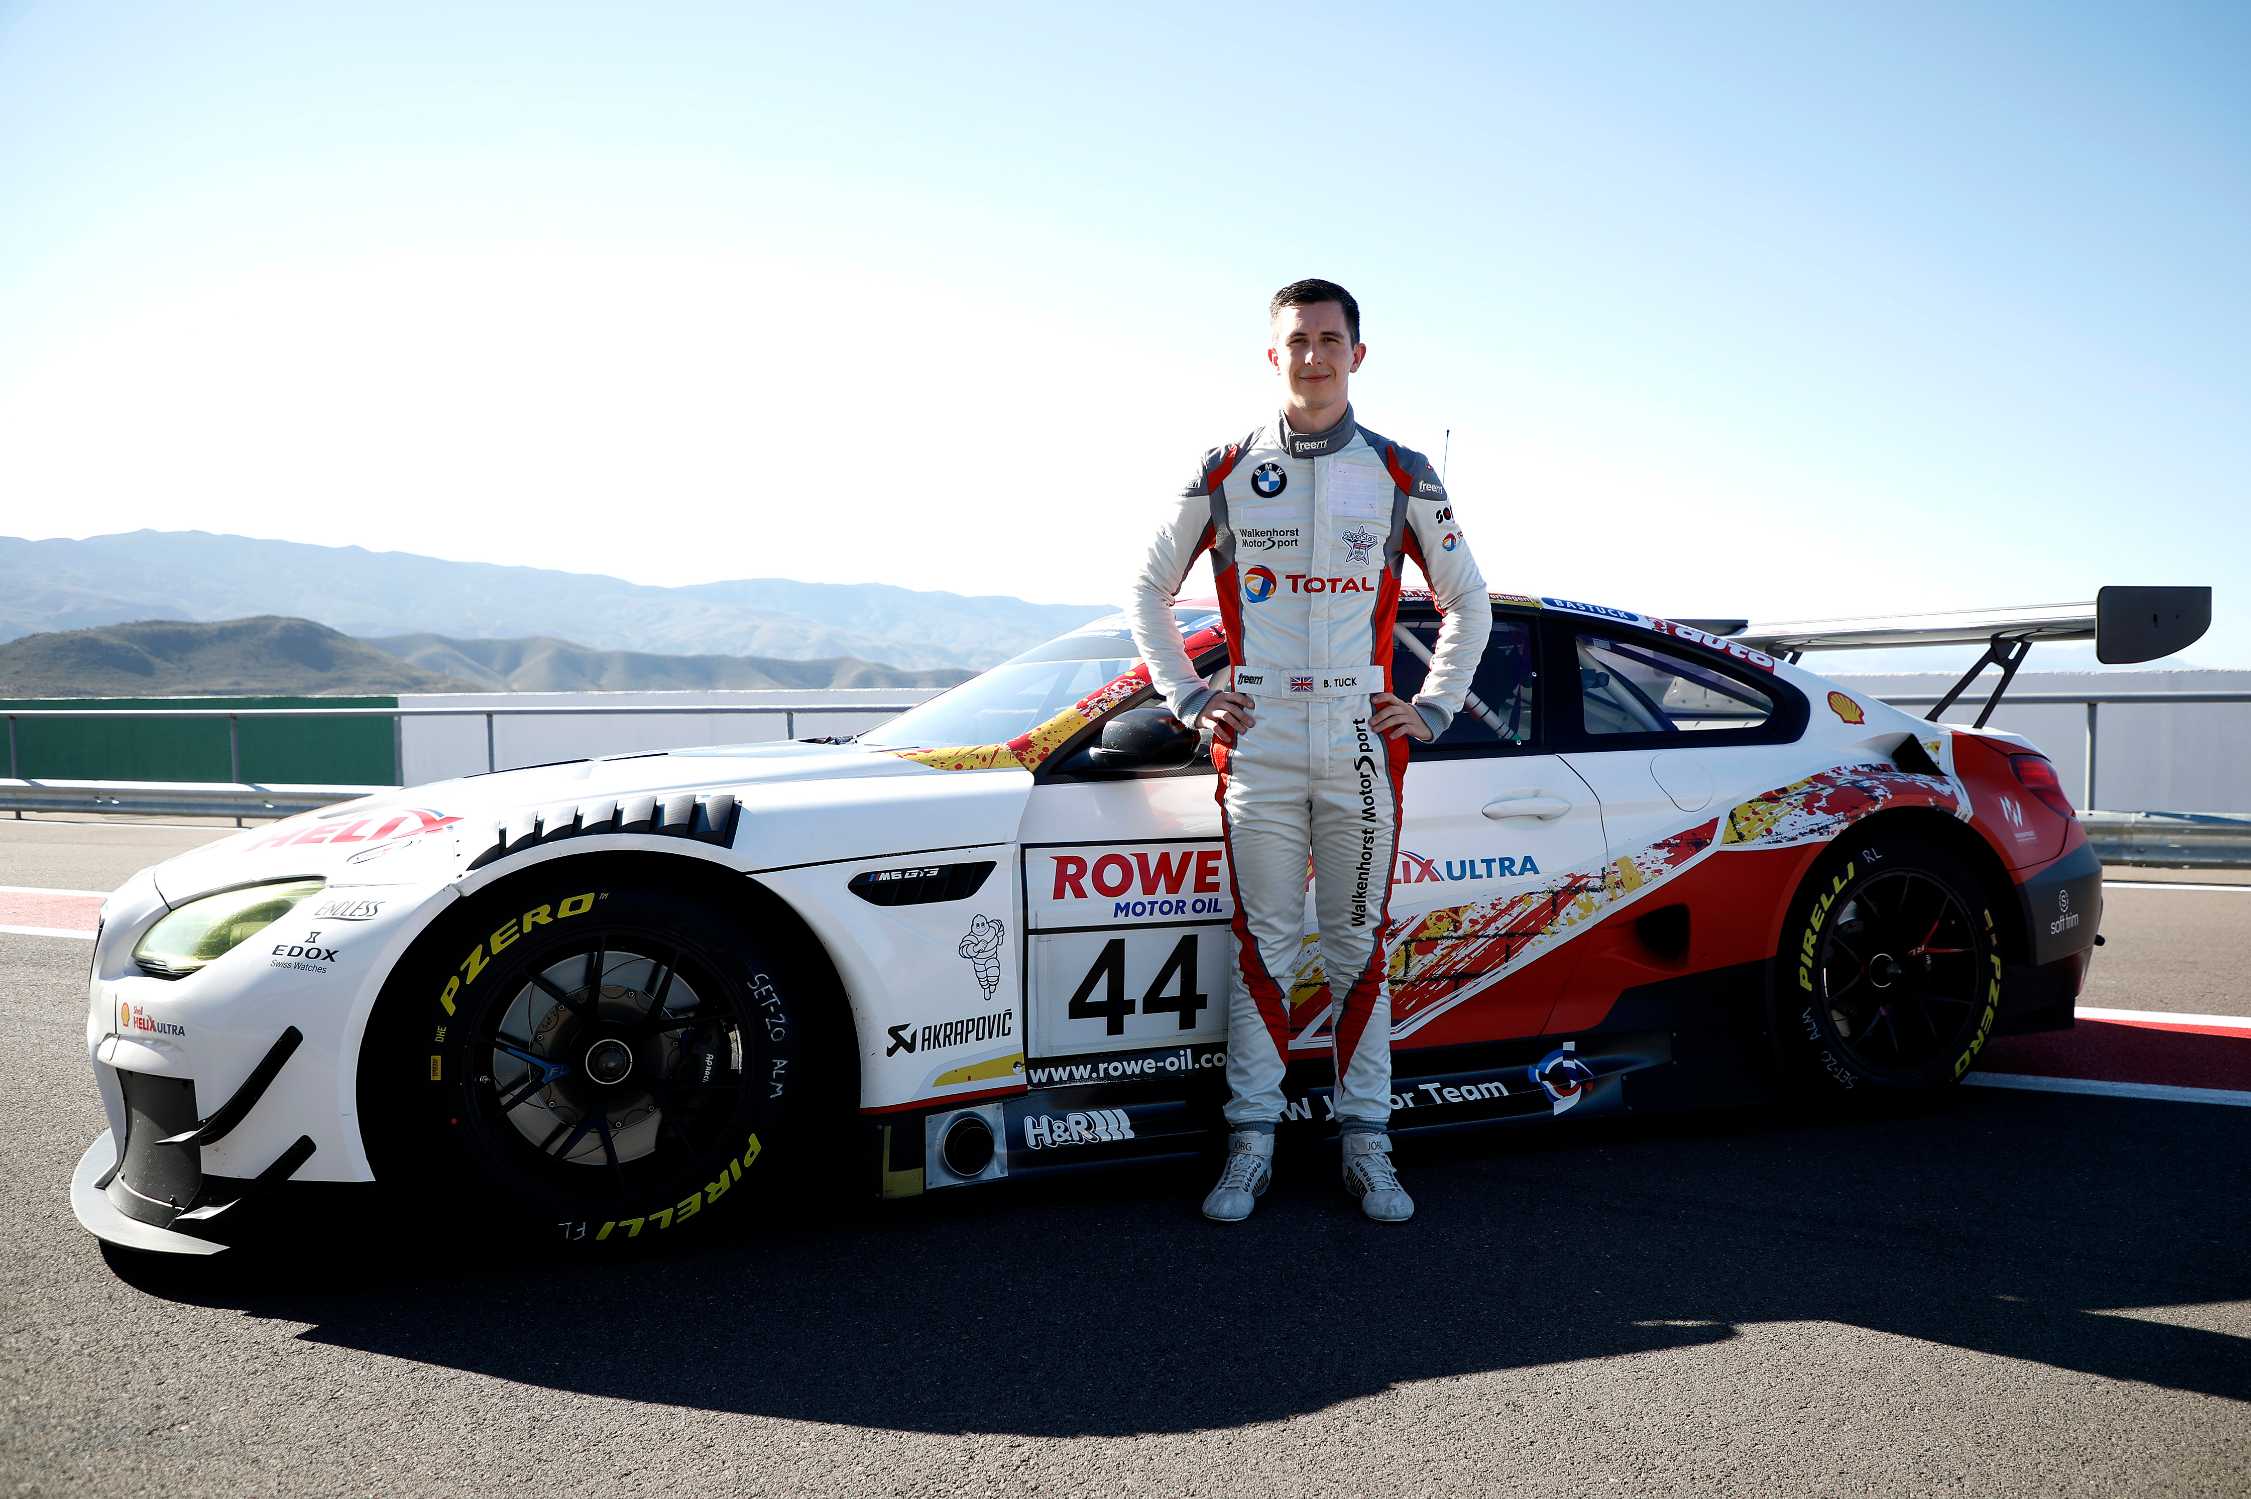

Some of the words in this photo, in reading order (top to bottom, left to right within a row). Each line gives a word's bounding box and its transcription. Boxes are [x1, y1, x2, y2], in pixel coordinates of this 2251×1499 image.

[1255, 464, 1284, 476] BMW
[1239, 528, 1299, 537] Walkenhorst
[1285, 574, 1375, 593] TOTAL
[1554, 599, 1629, 619] BASTUCK
[1675, 624, 1774, 669] auto
[1323, 680, 1332, 688] B.
[1334, 677, 1357, 688] TUCK
[241, 808, 464, 852] HELIX
[879, 871, 902, 881] M6
[1050, 850, 1223, 900] ROWE
[1352, 827, 1375, 927] Walkenhorst
[1446, 855, 1540, 881] ULTRA
[314, 900, 385, 917] ENDLESS
[1113, 900, 1187, 918] MOTOR
[1192, 898, 1223, 914] OIL
[1798, 861, 1856, 992] PIRELLI
[2050, 914, 2065, 935] soft
[272, 944, 339, 962] EDOX
[270, 959, 292, 969] Swiss
[293, 961, 327, 974] Watches
[1068, 934, 1208, 1036] 44
[133, 1015, 156, 1032] HELIX
[157, 1022, 185, 1036] ULTRA
[1029, 1049, 1227, 1083] www.rowe-oil.co
[1418, 1079, 1509, 1105] Team
[1024, 1112, 1099, 1149] H&R
[596, 1133, 762, 1241] PIRELLI
